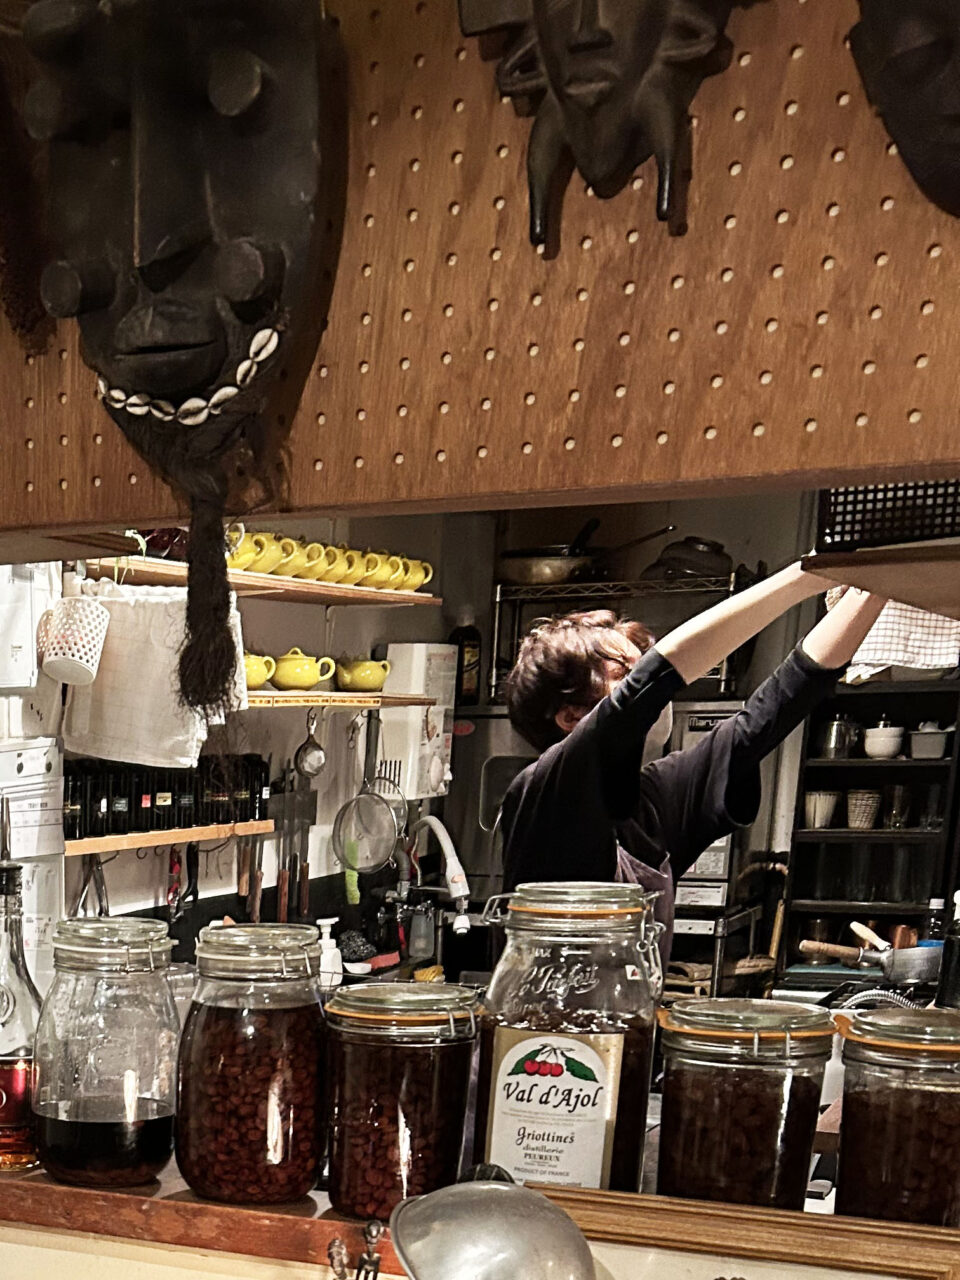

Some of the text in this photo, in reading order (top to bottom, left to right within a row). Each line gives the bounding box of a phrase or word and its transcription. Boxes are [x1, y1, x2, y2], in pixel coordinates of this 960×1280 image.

[503, 1081, 604, 1113] Val d'Ajol
[522, 1143, 565, 1154] distillerie
[524, 1153, 560, 1162] PEUREUX
[514, 1166, 538, 1175] PRODUCT
[548, 1170, 571, 1178] FRANCE
